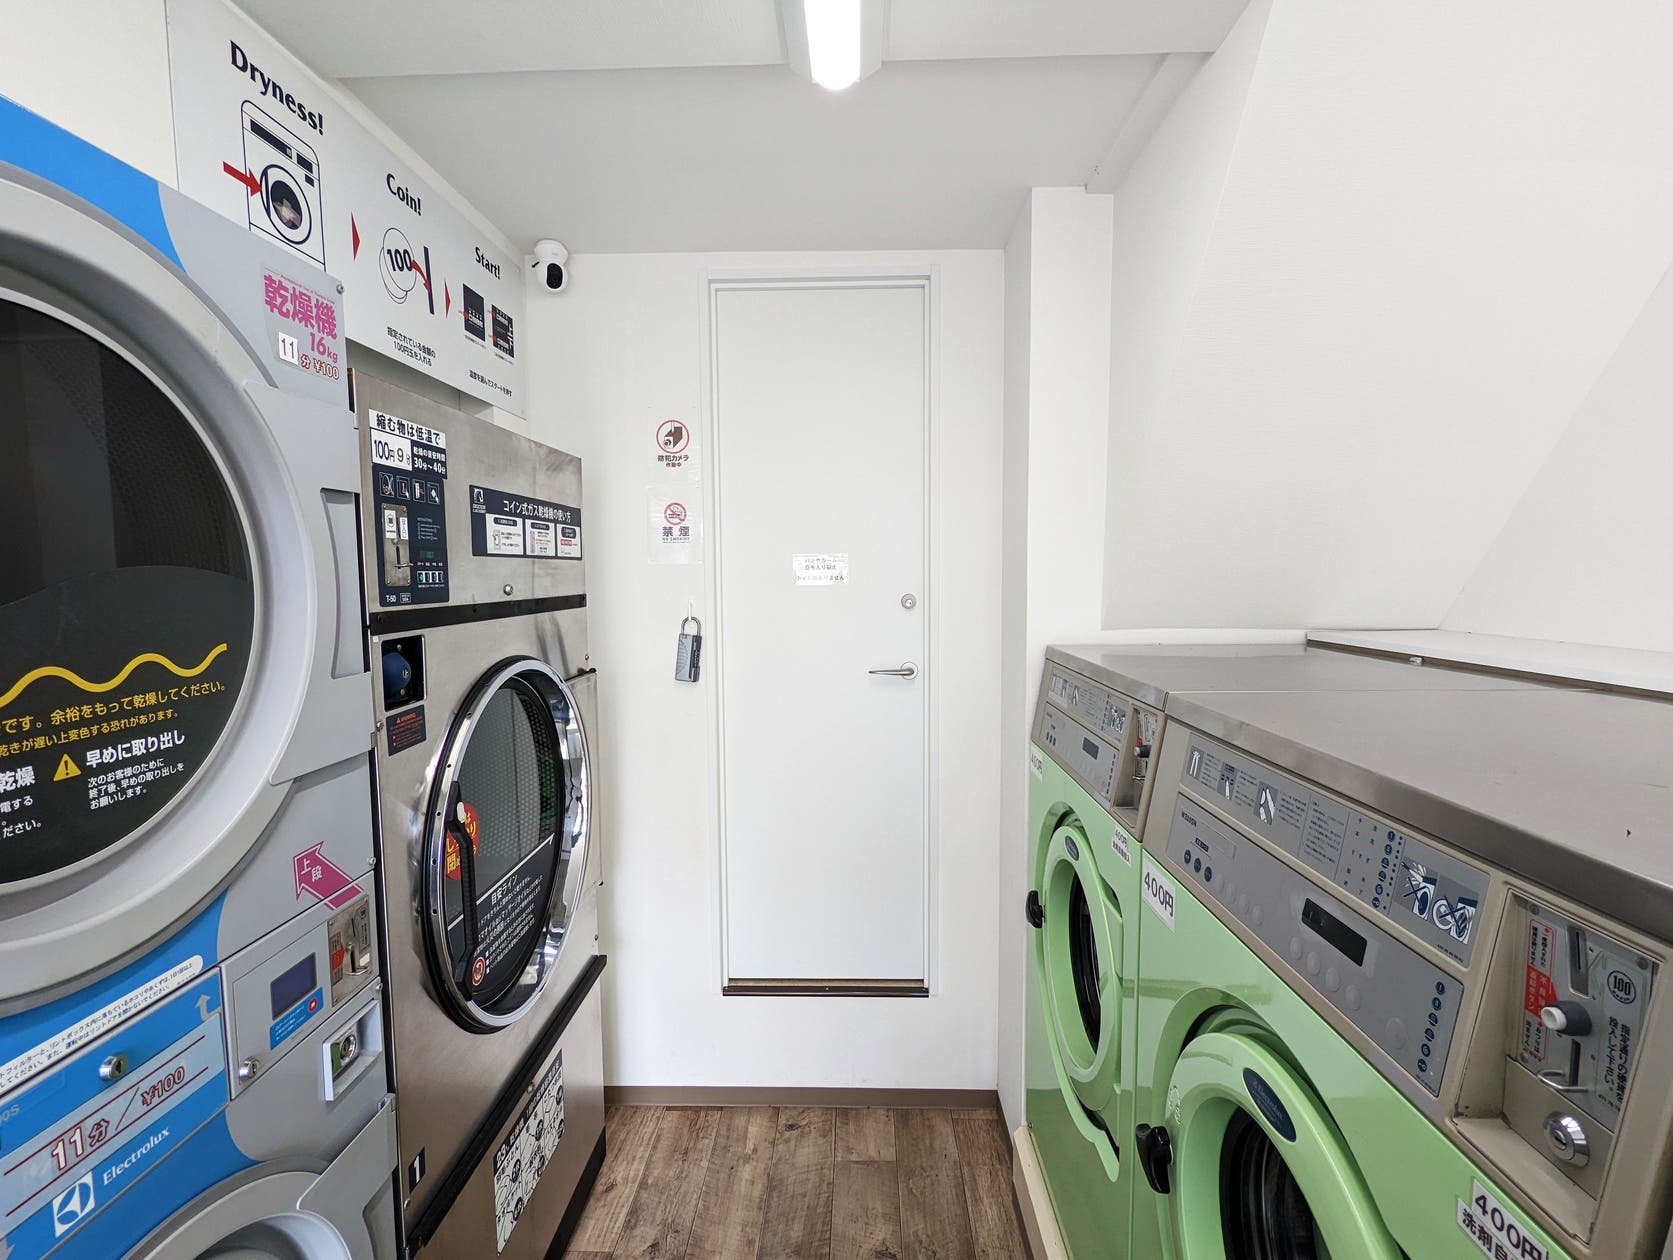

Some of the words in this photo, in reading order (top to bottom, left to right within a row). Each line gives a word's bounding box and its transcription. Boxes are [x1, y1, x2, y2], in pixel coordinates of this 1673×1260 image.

[230, 40, 324, 136] Dryness!
[386, 174, 422, 216] Coin!
[387, 248, 414, 273] 100
[475, 246, 500, 280] Start!
[264, 275, 337, 340] 乾燥機
[281, 338, 295, 359] 11
[300, 354, 311, 370] 分
[314, 358, 340, 380] ¥100
[310, 332, 338, 363] 16kg
[376, 413, 440, 445] 縮む物は低温で
[374, 439, 395, 463] 100円
[658, 454, 689, 462] 防犯カメラ
[503, 500, 571, 523] コイン式ガス乾燥機の使い方
[662, 526, 690, 537] 禁煙
[86, 730, 185, 769] 早めに取り出し
[88, 758, 164, 788] 次のお客様のために
[88, 763, 185, 799] 終了後、早めの取り出しを
[89, 787, 148, 810] お願いします。
[301, 859, 323, 882] 上段
[1144, 871, 1174, 918] 400円
[1613, 975, 1631, 996] 100
[141, 1066, 185, 1107] ¥100
[103, 1128, 170, 1185] Electrolux
[413, 1156, 420, 1183] 1
[1475, 1194, 1544, 1260] 400円
